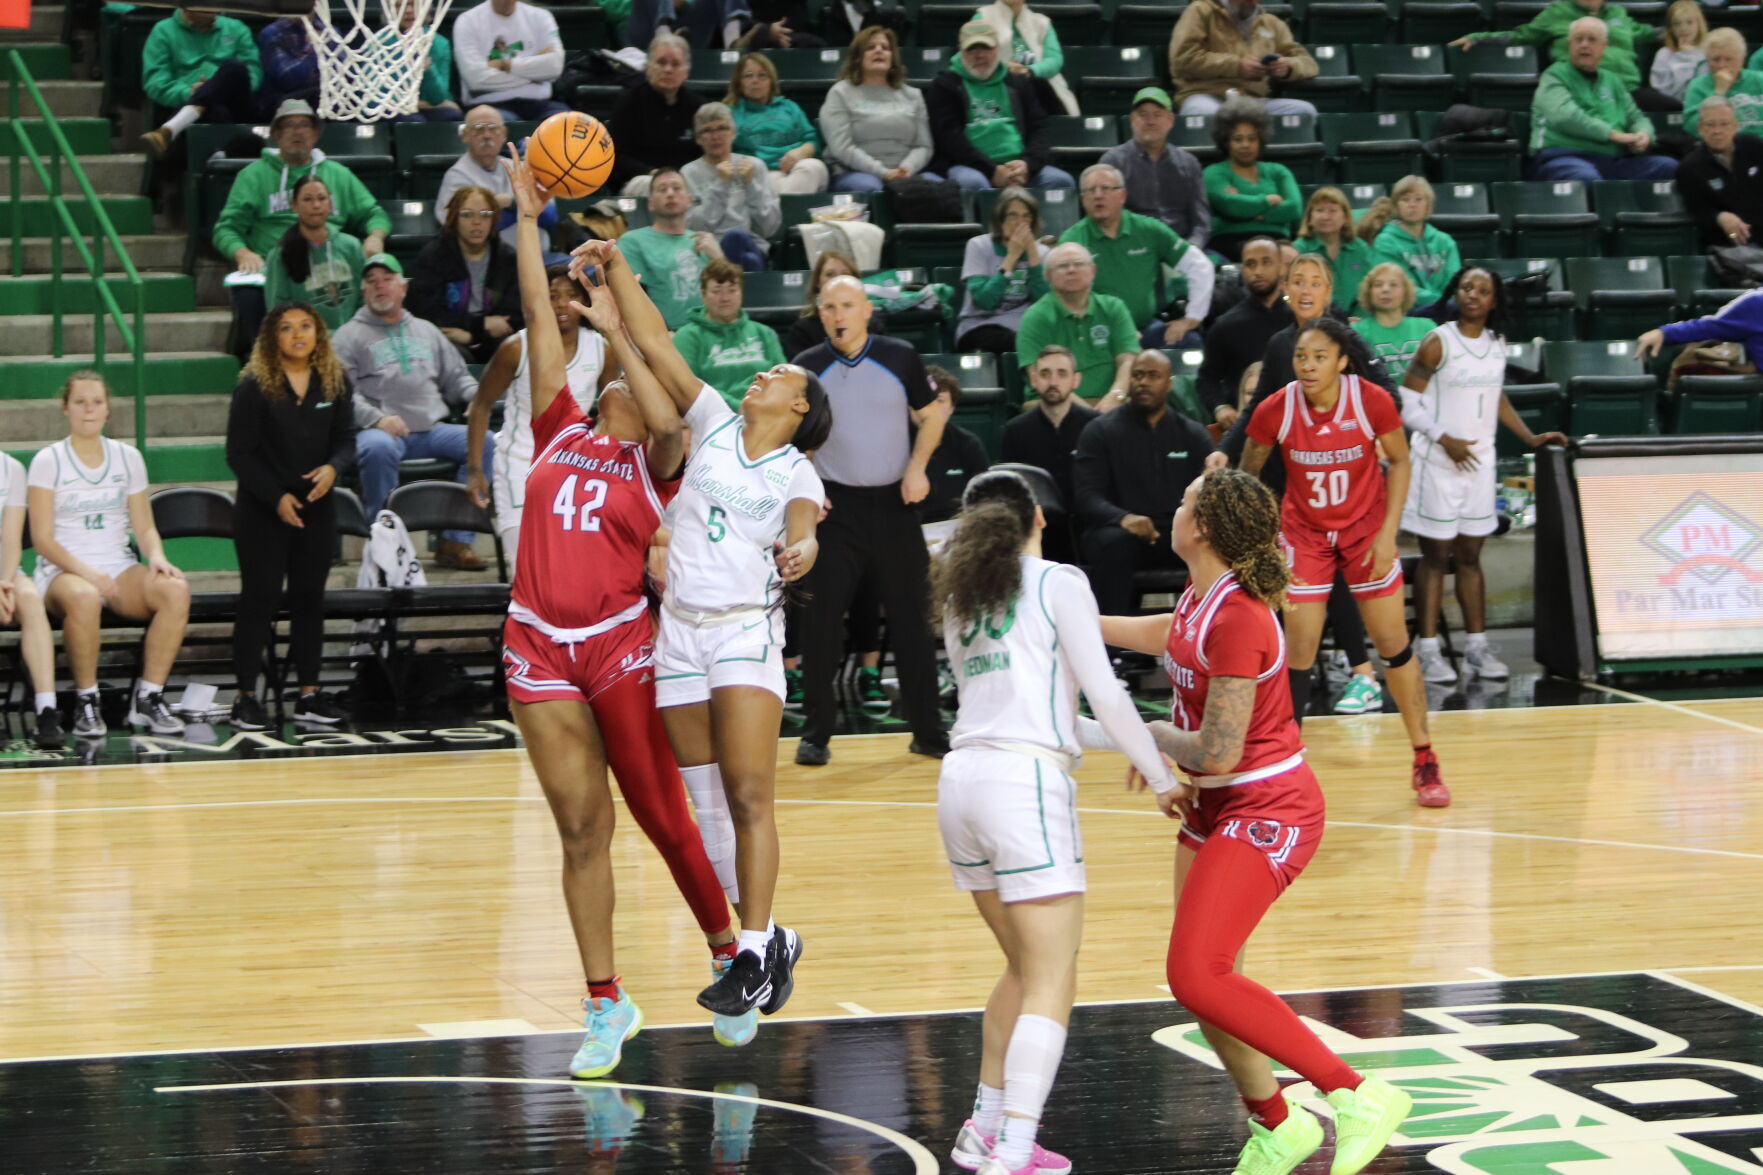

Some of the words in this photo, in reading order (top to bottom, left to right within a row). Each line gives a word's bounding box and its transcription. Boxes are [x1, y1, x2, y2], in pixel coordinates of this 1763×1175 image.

[599, 459, 634, 481] STATE
[1305, 469, 1349, 508] 30
[552, 473, 608, 532] 42
[686, 463, 779, 520] Marshall
[707, 505, 727, 543] 5
[1680, 524, 1733, 552] PM
[1616, 590, 1663, 613] Par
[1669, 586, 1726, 611] Mar
